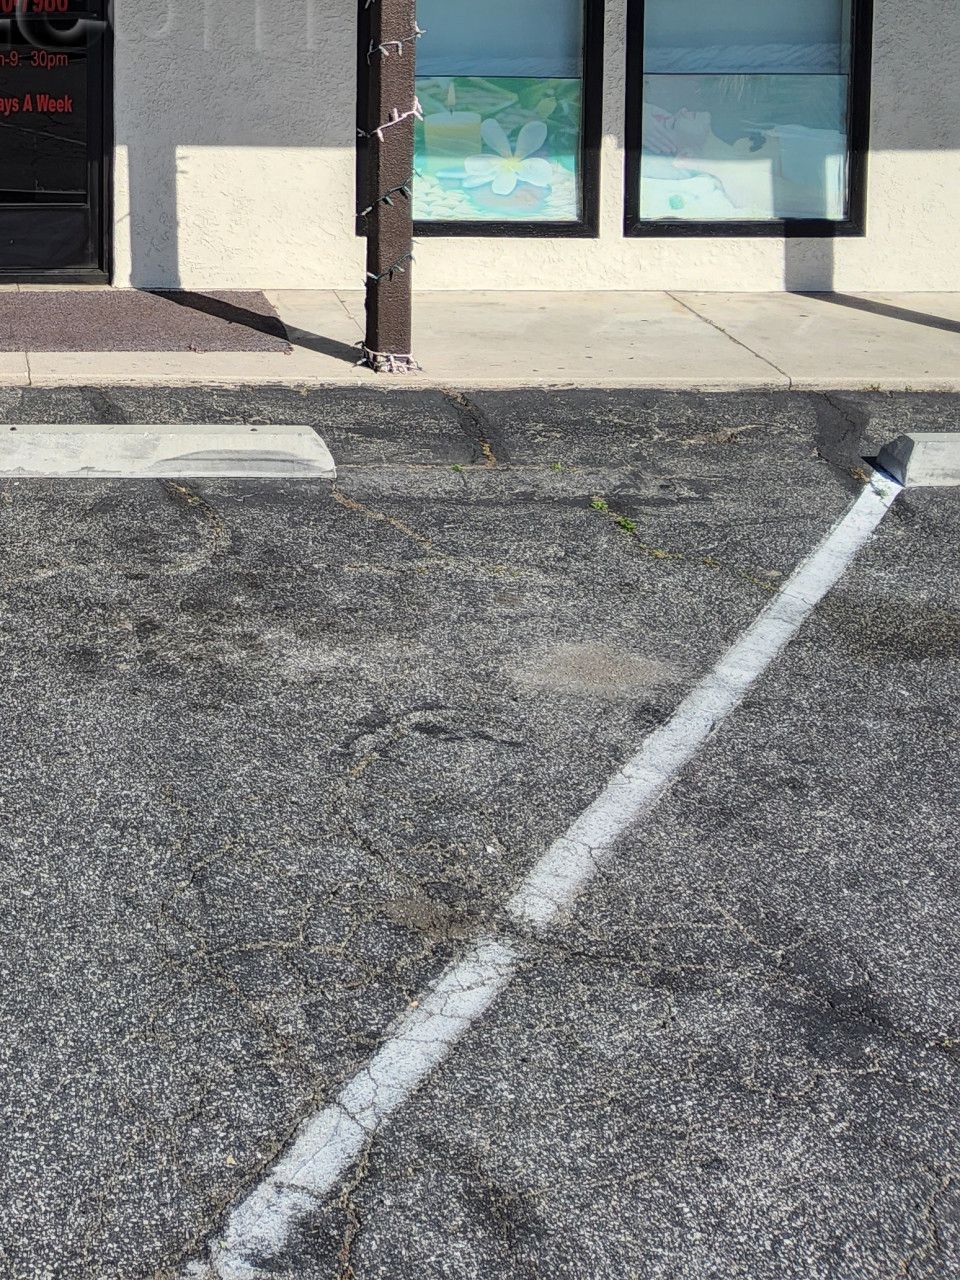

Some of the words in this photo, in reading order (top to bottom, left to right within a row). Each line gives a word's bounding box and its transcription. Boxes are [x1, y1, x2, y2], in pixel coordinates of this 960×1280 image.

[31, 51, 69, 69] 30pm
[23, 94, 33, 111] A
[35, 94, 73, 112] Week
